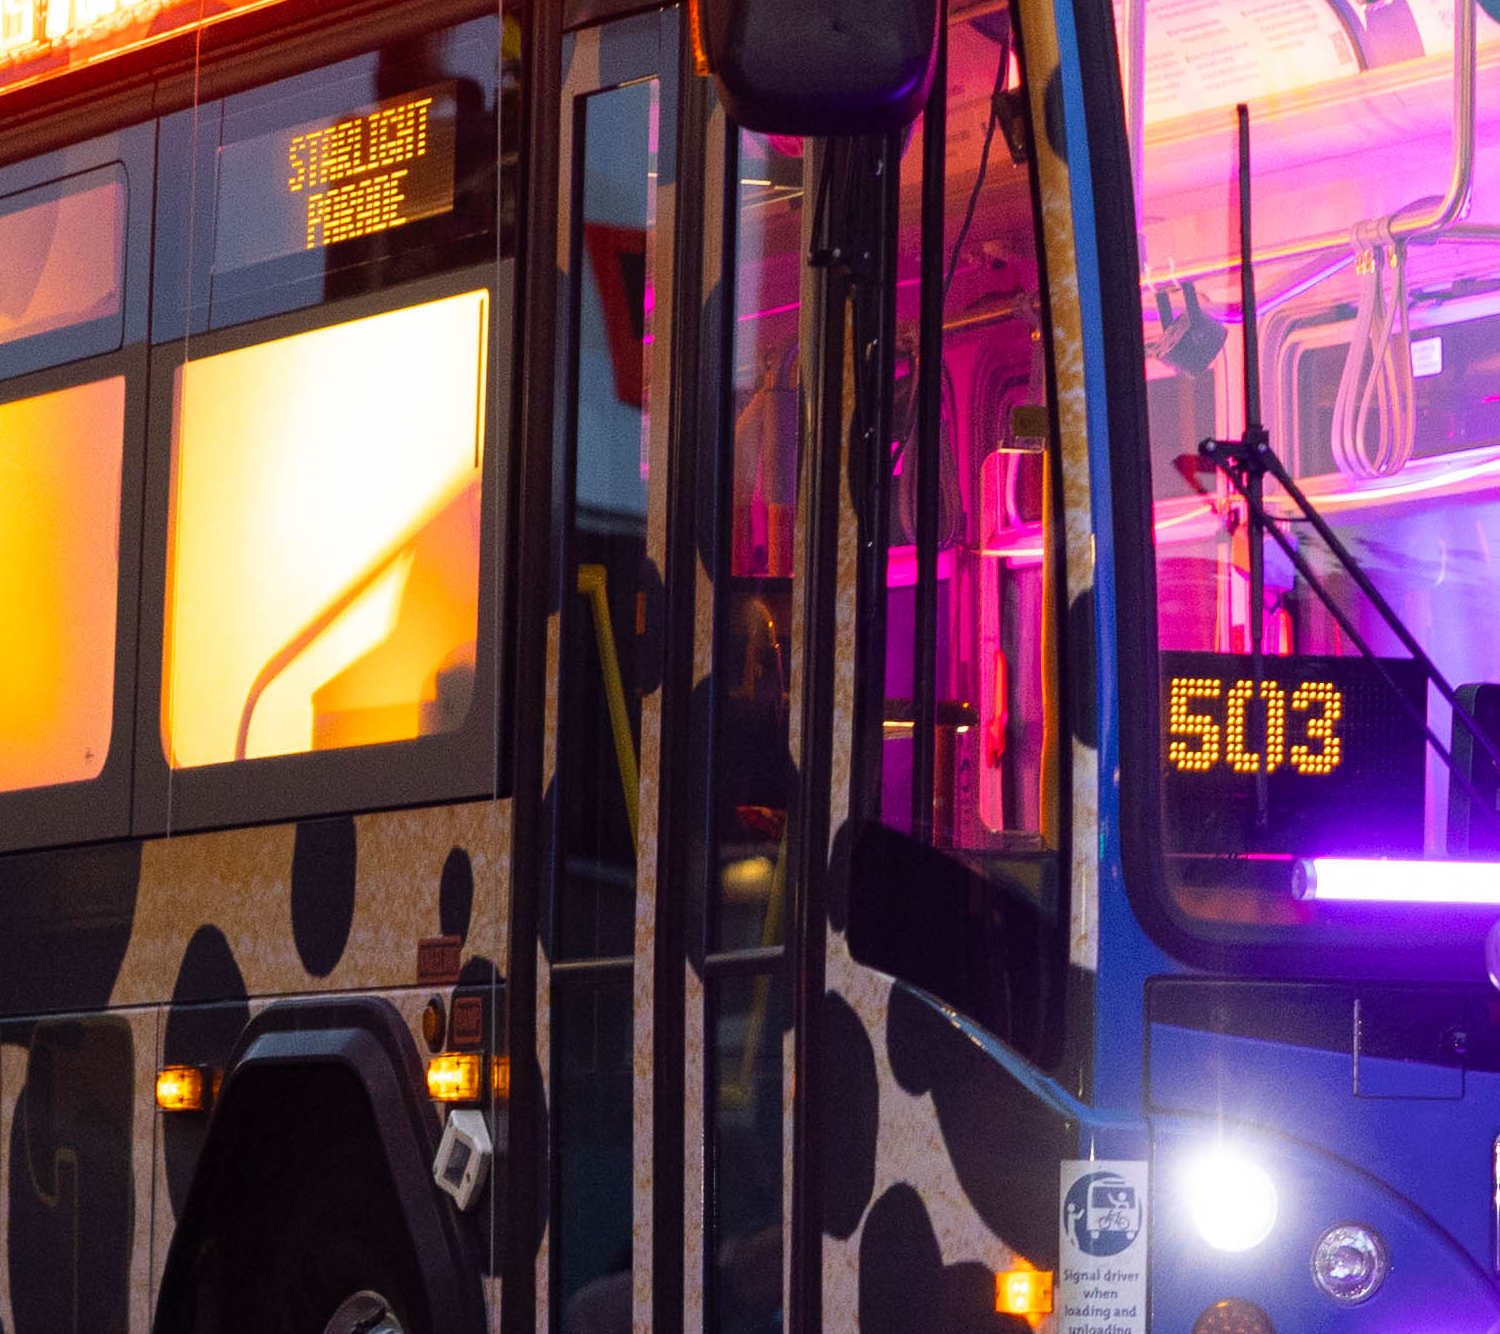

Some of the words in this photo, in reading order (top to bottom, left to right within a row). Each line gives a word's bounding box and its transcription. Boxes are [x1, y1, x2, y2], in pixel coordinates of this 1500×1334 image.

[288, 97, 433, 193] STARLIGHT
[306, 168, 409, 250] PARADE
[1168, 677, 1342, 776] 503
[1063, 1269, 1100, 1285] Signal
[1103, 1269, 1140, 1282] driver
[1083, 1288, 1118, 1300] when
[1064, 1304, 1110, 1321] loading
[1113, 1305, 1137, 1318] and
